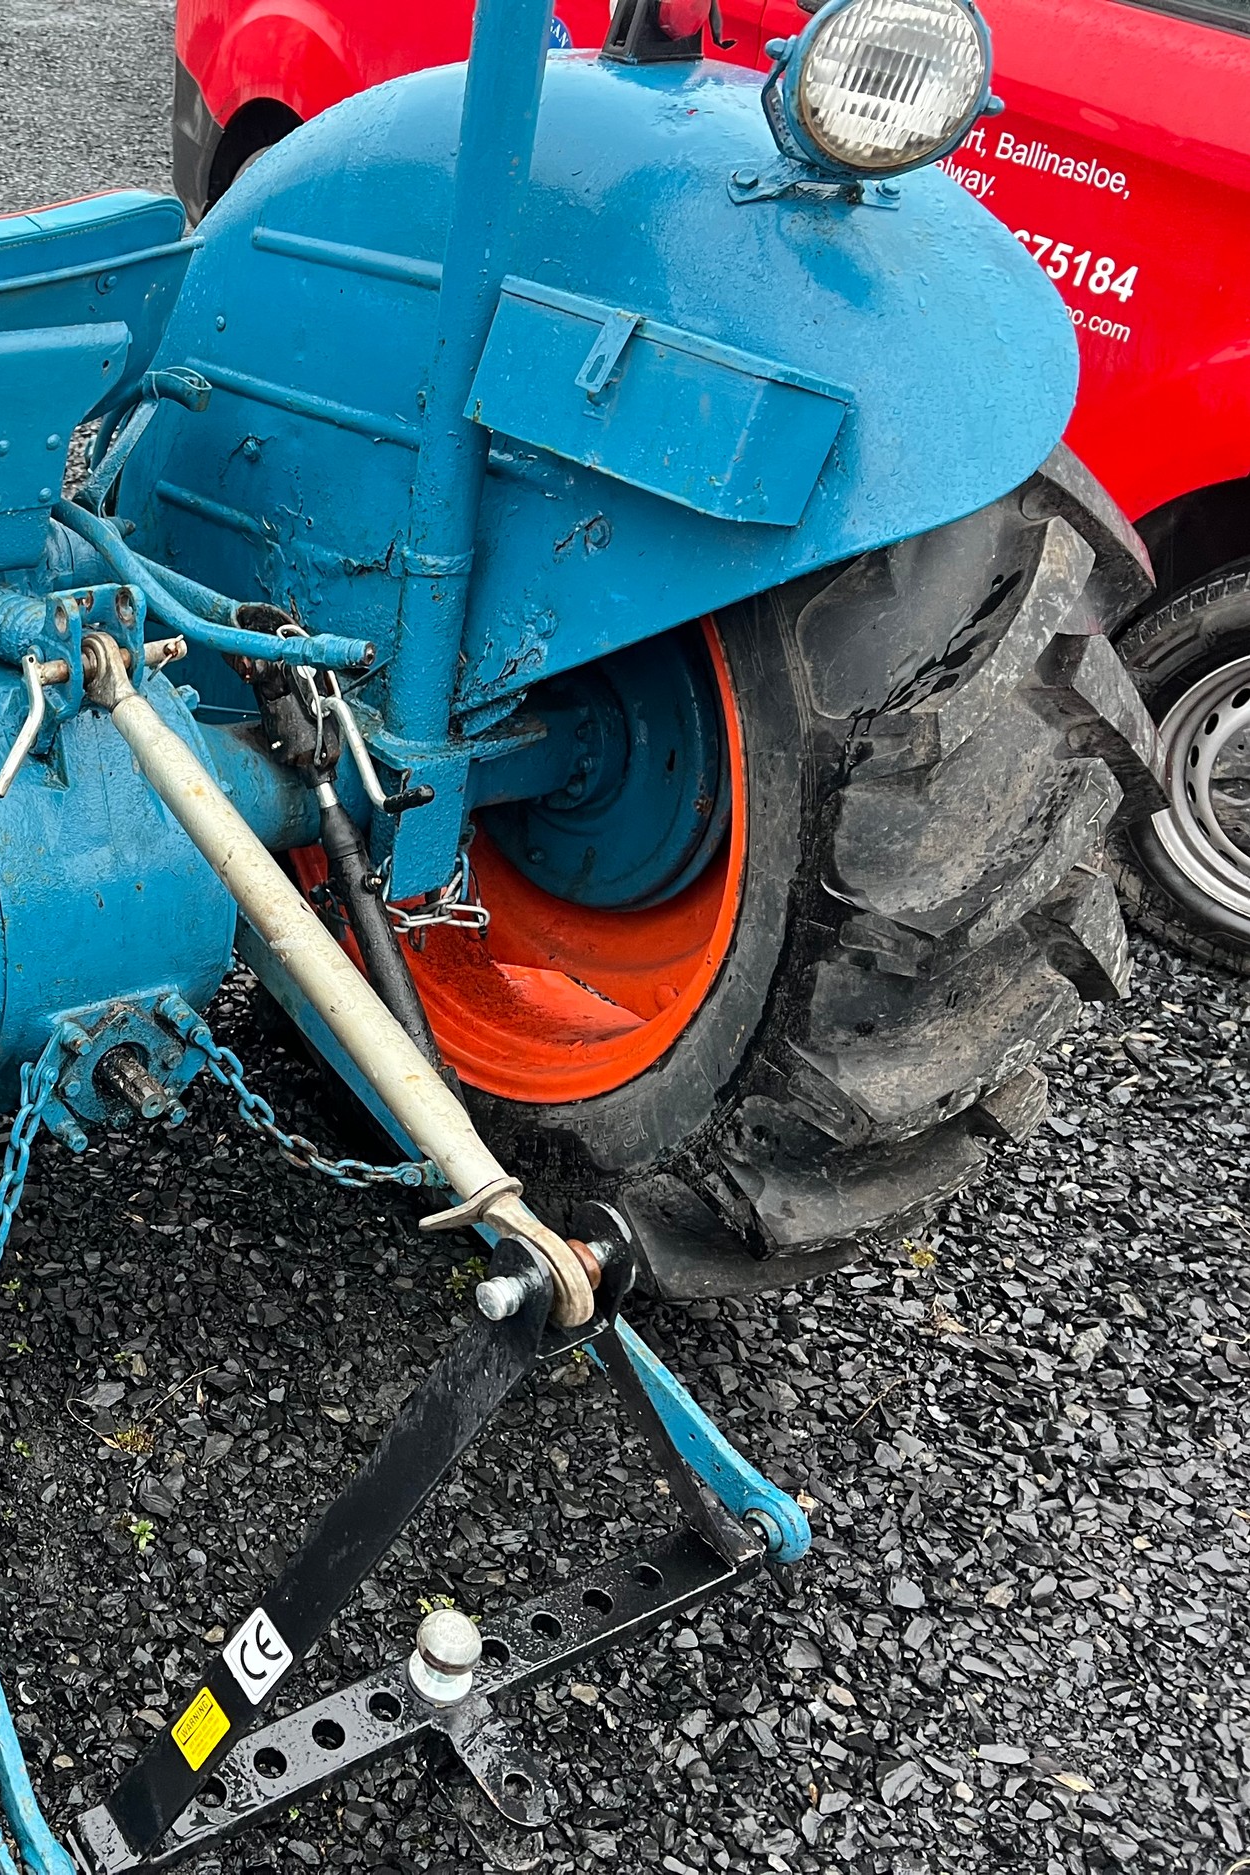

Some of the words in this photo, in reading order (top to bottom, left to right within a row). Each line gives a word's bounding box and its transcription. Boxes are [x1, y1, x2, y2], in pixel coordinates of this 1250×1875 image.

[995, 132, 1132, 200] Ballinasloe,
[240, 1620, 283, 1680] CE
[180, 1700, 209, 1738] WARNING
